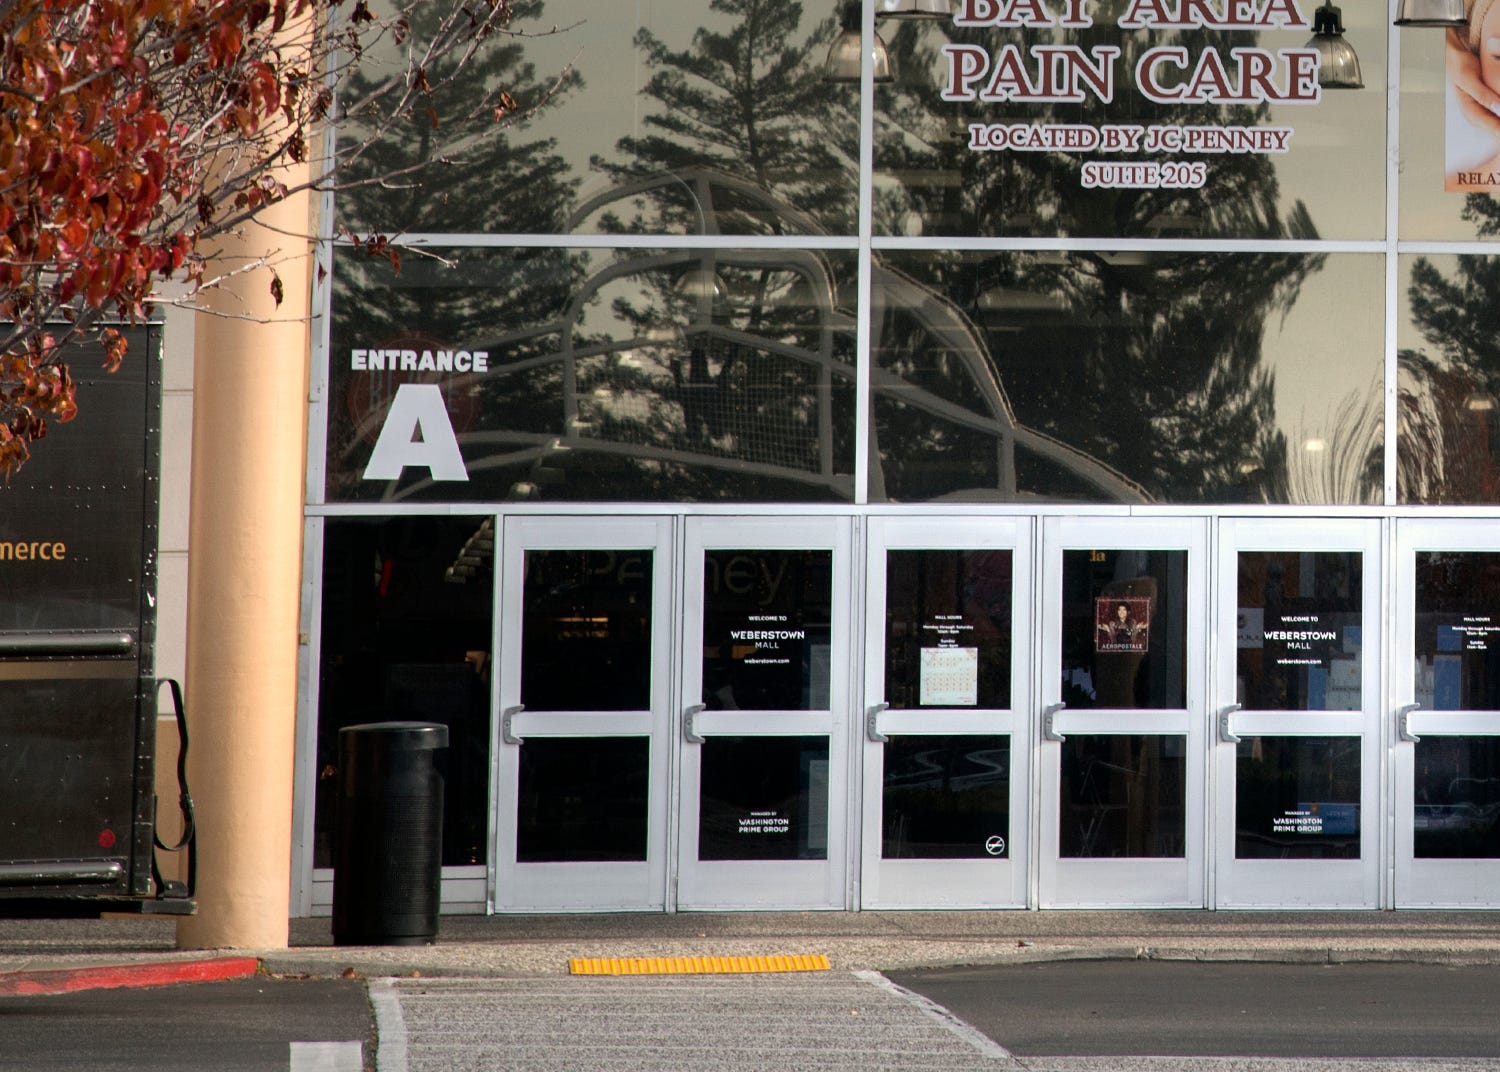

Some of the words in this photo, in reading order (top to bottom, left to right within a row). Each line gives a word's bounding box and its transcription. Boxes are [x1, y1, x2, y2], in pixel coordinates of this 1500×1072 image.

[943, 46, 1119, 102] PAIN
[1137, 48, 1321, 102] CARE
[971, 127, 1097, 151] LOCATED
[1103, 128, 1139, 151] BY
[1186, 129, 1292, 151] PENNEY
[1084, 164, 1159, 187] SUITE
[1163, 165, 1205, 187] 205
[351, 348, 489, 373] ENTRANCE
[362, 383, 470, 481] A
[730, 630, 805, 640] WEBERSTOWN
[1264, 631, 1337, 641] WEBERSTOWN
[755, 641, 780, 649] MALL
[1287, 642, 1312, 650] MALL
[1273, 825, 1296, 833] PRIME
[1297, 825, 1322, 833] GROUP
